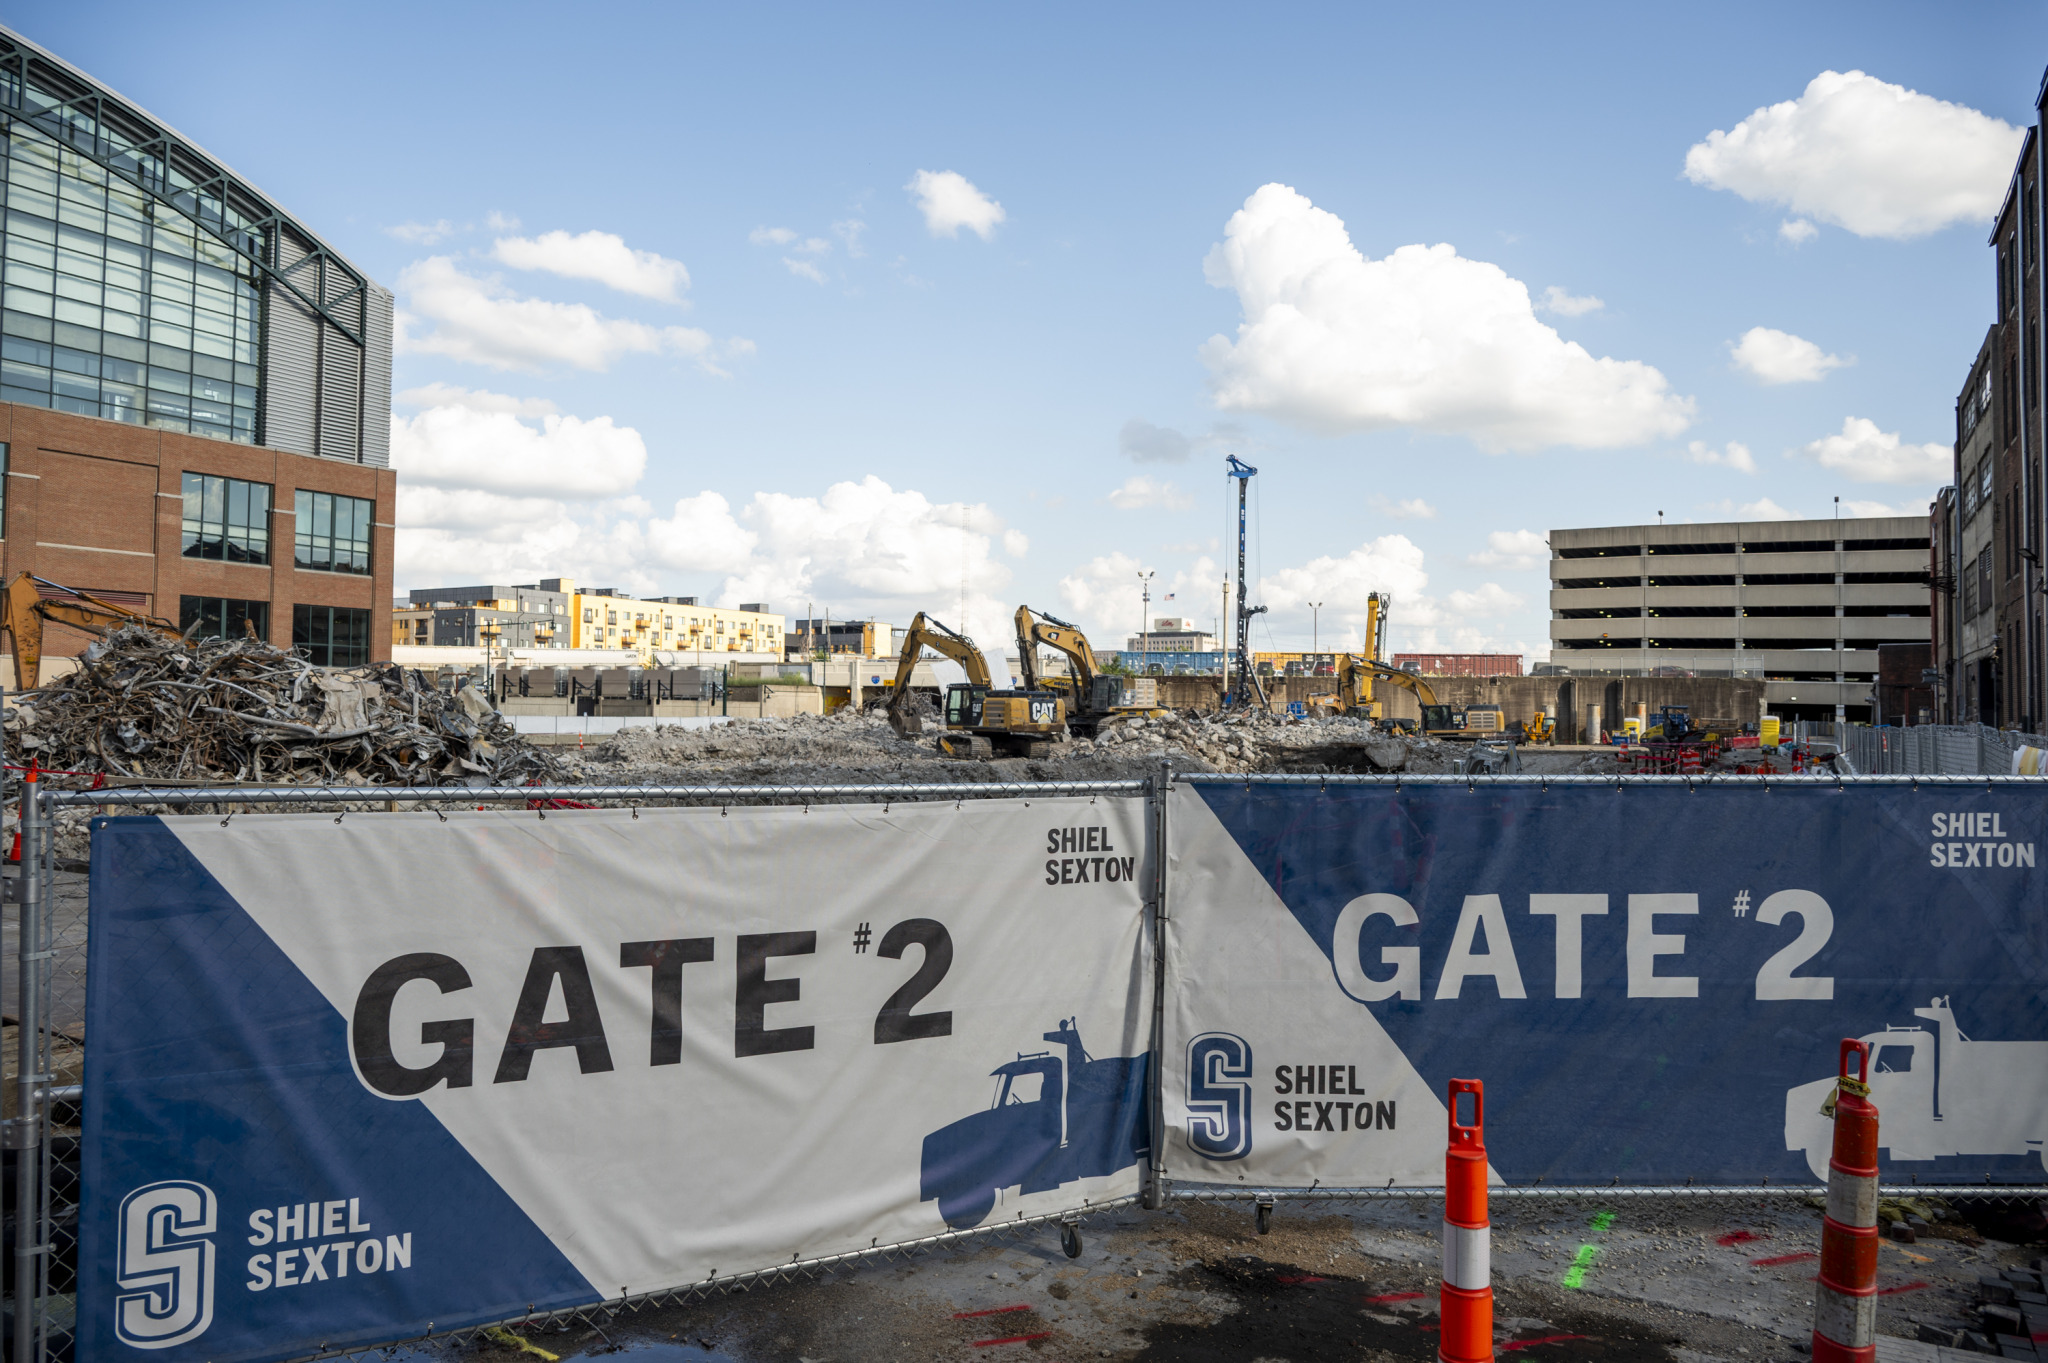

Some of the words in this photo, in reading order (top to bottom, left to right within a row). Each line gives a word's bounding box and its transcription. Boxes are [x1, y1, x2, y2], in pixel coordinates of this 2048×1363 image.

[1032, 702, 1055, 721] CAT
[1047, 826, 1113, 855] SHIEL
[1931, 812, 2007, 839] SHIEL
[1045, 856, 1135, 886] SEXTON
[1930, 842, 2035, 869] SEXTON
[1332, 892, 1699, 1002] GATE
[1732, 888, 1835, 1001] #2
[352, 930, 816, 1097] GATE
[853, 918, 954, 1045] #2
[1274, 1064, 1364, 1095] SHIEL
[1274, 1101, 1397, 1132] SEXTON
[248, 1197, 370, 1246] SHIEL
[246, 1232, 412, 1292] SEXTON
